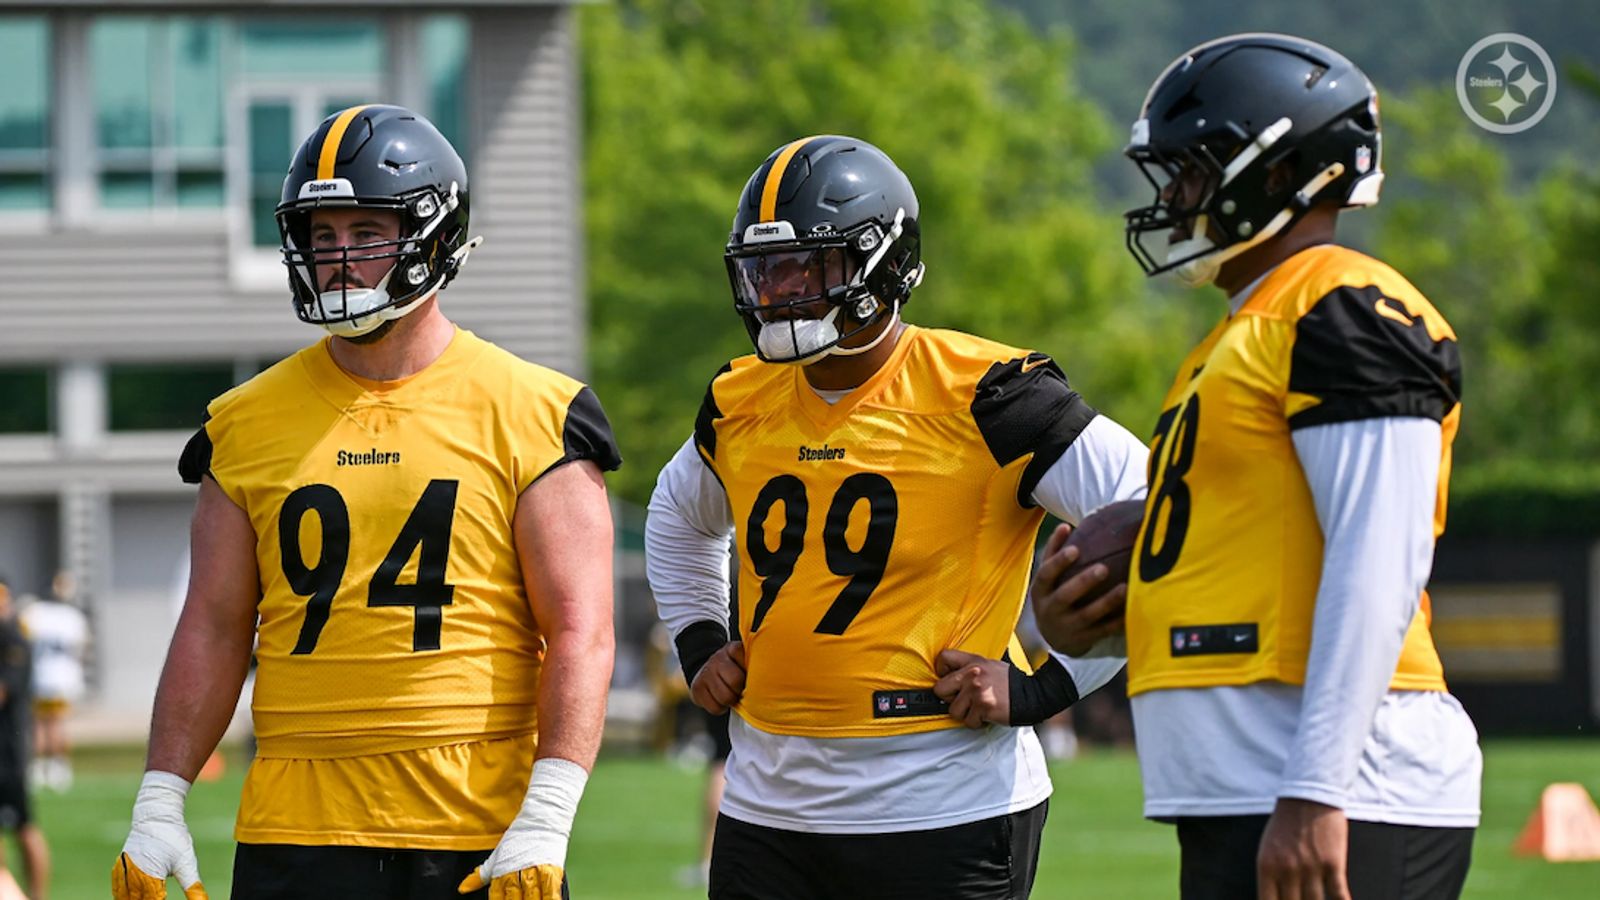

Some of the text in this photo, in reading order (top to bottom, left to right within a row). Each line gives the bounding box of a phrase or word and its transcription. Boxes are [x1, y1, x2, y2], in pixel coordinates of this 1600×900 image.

[309, 181, 336, 192] Steelers
[753, 225, 779, 236] Steelers
[336, 448, 400, 467] Steelers
[798, 444, 846, 462] Steelers
[1138, 392, 1200, 583] 78
[746, 472, 898, 636] 99
[278, 479, 459, 655] 94
